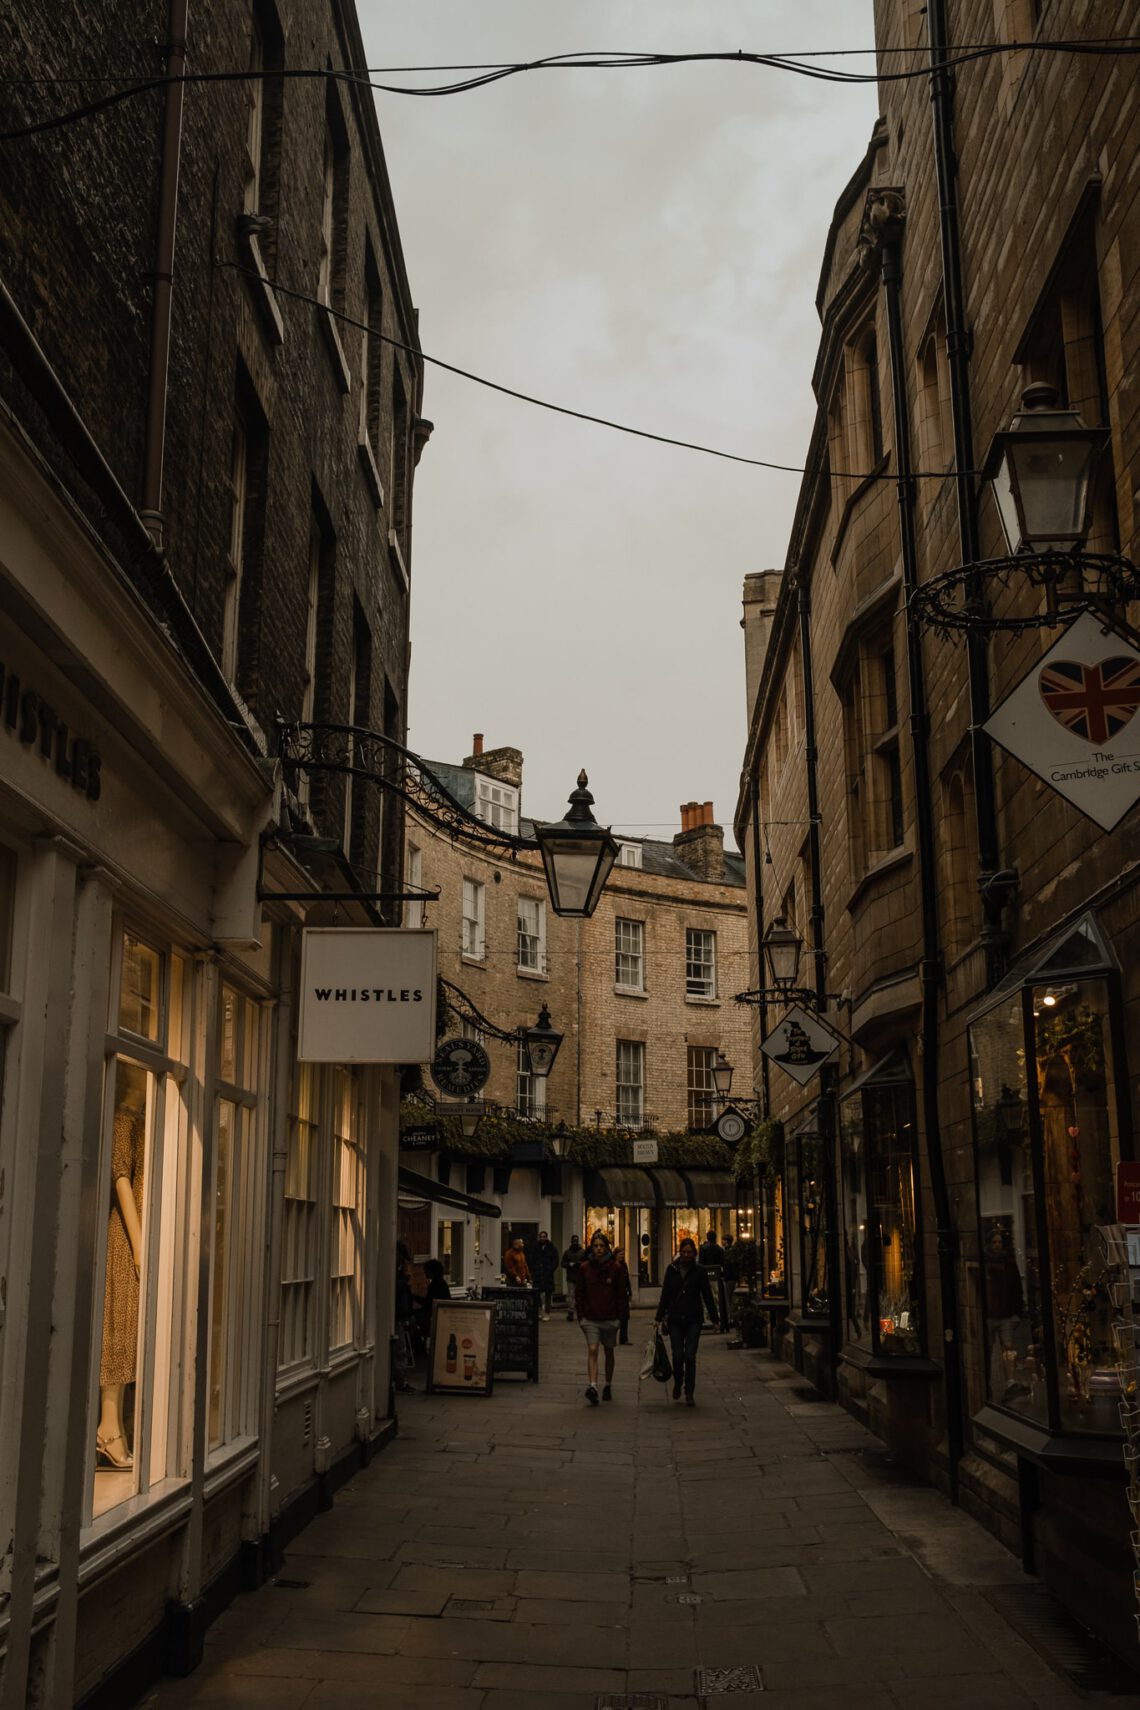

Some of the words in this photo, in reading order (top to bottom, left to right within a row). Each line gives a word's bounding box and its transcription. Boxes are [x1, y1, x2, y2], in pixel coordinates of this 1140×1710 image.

[1091, 752, 1114, 763] The
[1051, 766, 1109, 782] Cambridge
[1111, 762, 1132, 774] Gift
[315, 988, 423, 1002] WHISTLES
